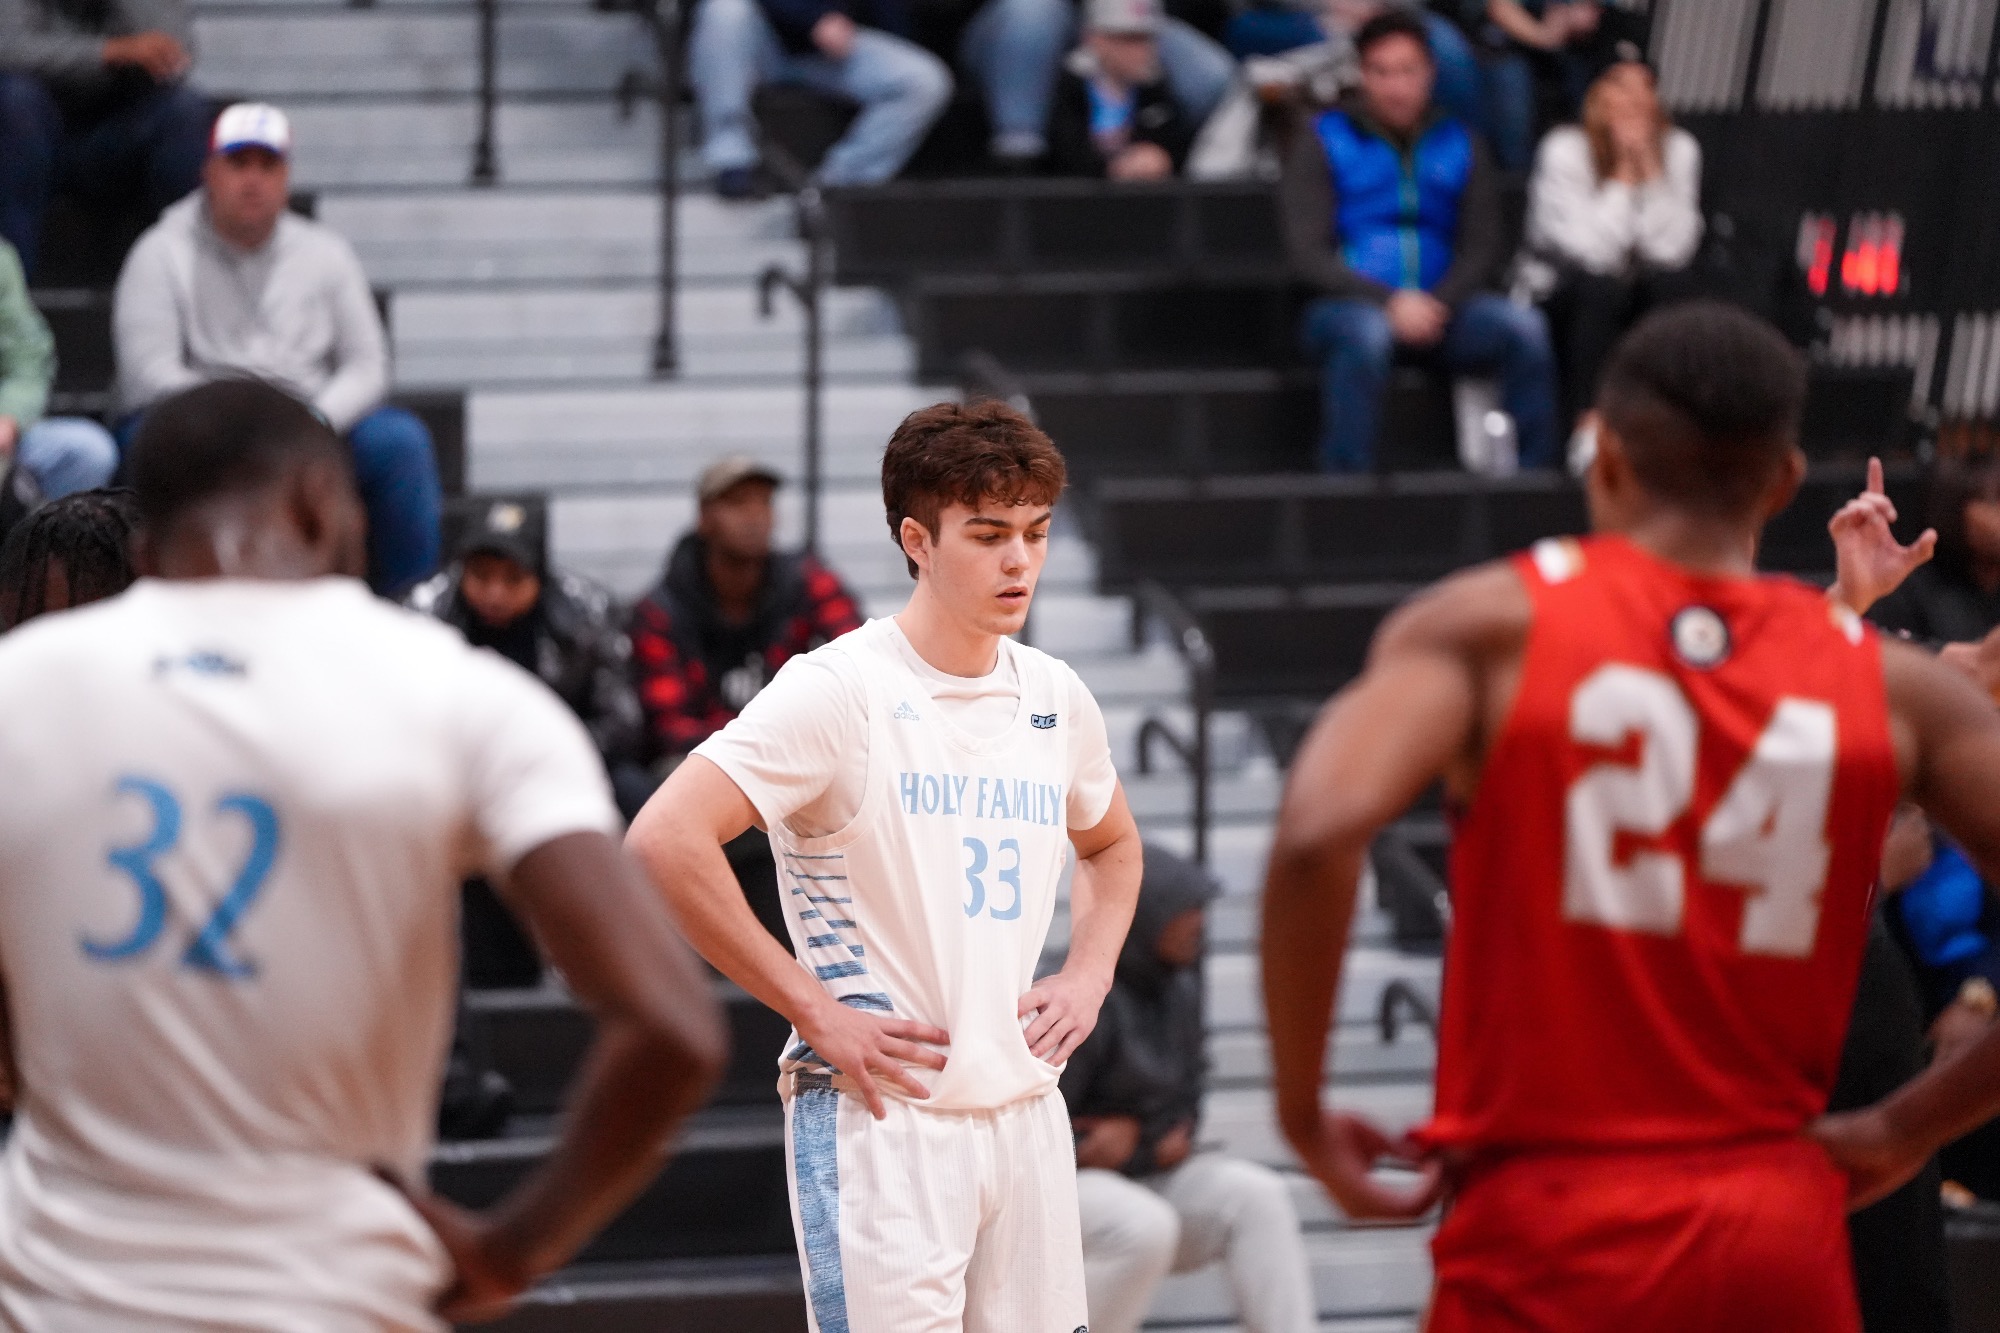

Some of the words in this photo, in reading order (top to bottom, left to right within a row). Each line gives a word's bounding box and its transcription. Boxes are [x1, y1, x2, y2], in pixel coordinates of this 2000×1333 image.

[900, 772, 968, 816] HOLY
[976, 777, 1062, 826] FAMILY
[1559, 660, 1833, 961] 24
[78, 773, 279, 982] 32
[963, 837, 1022, 921] 33
